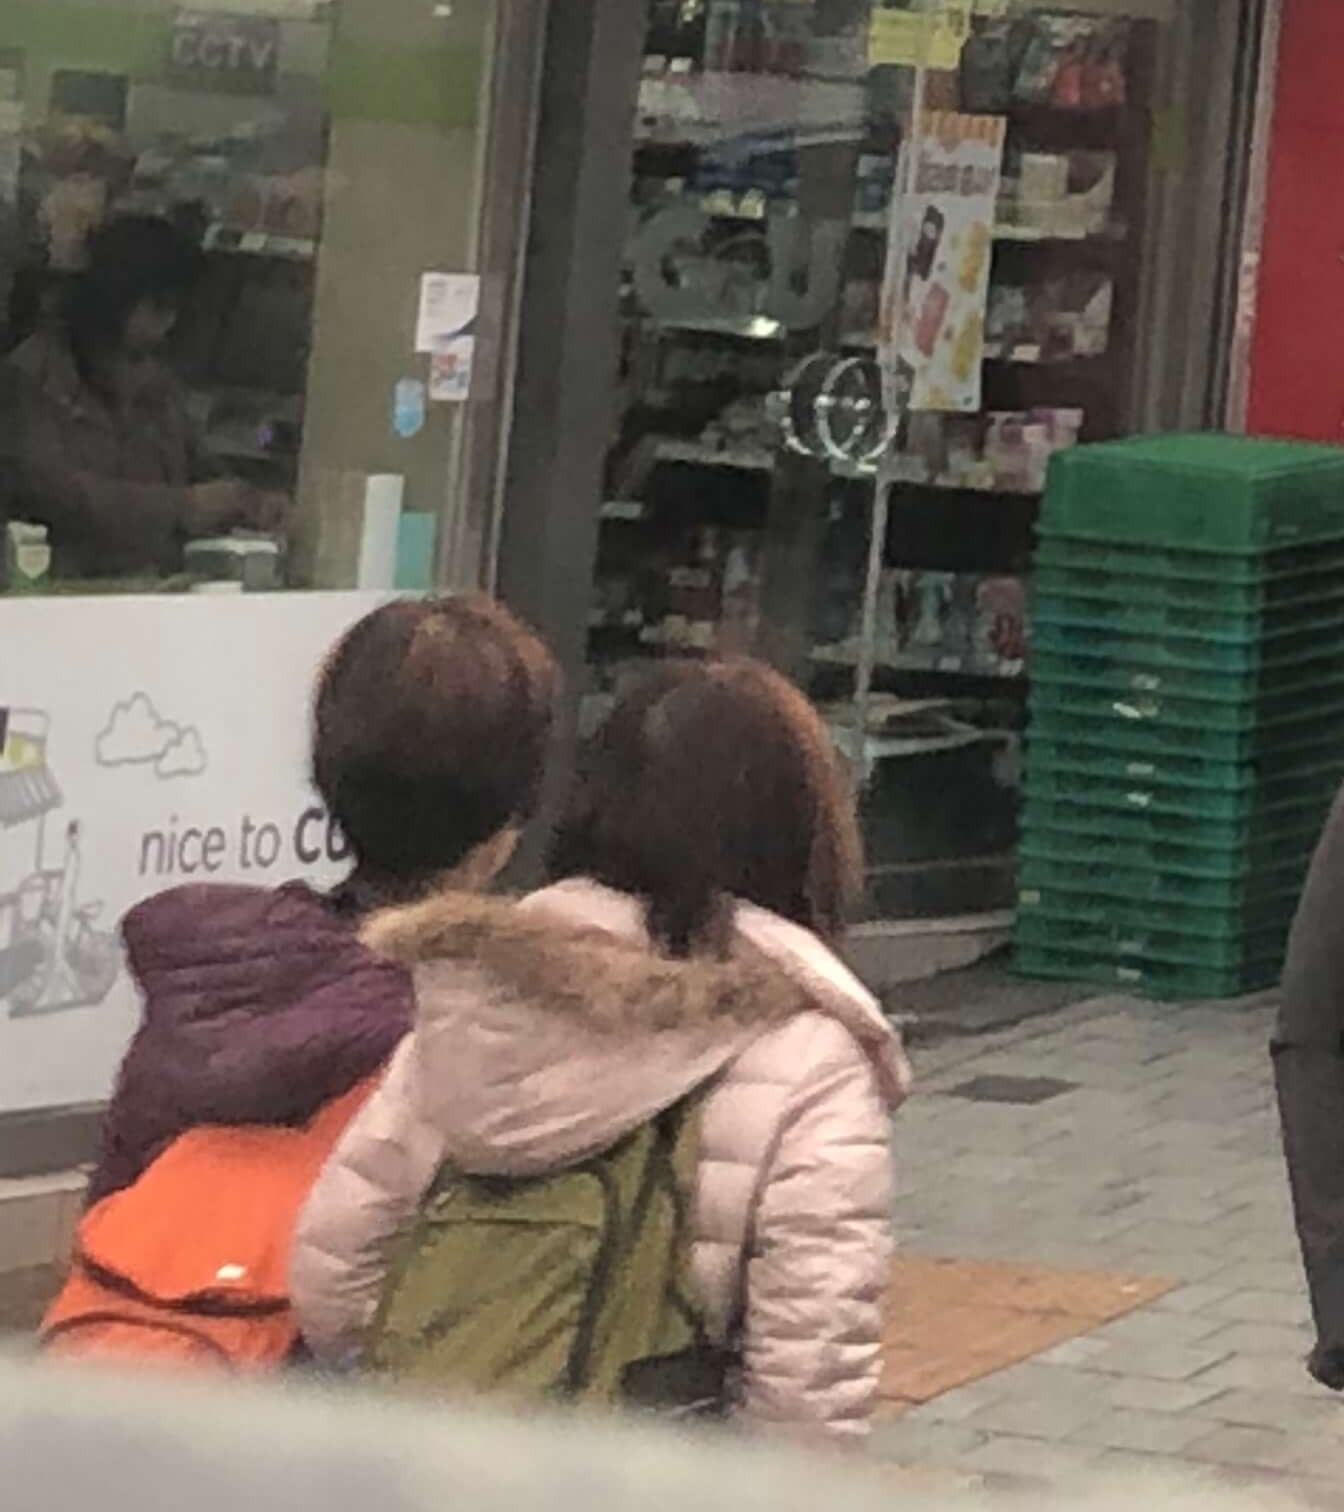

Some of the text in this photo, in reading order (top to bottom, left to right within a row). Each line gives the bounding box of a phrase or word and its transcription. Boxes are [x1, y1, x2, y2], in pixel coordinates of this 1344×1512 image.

[174, 35, 273, 69] CCTV
[138, 814, 226, 877] nice
[240, 813, 282, 871] to
